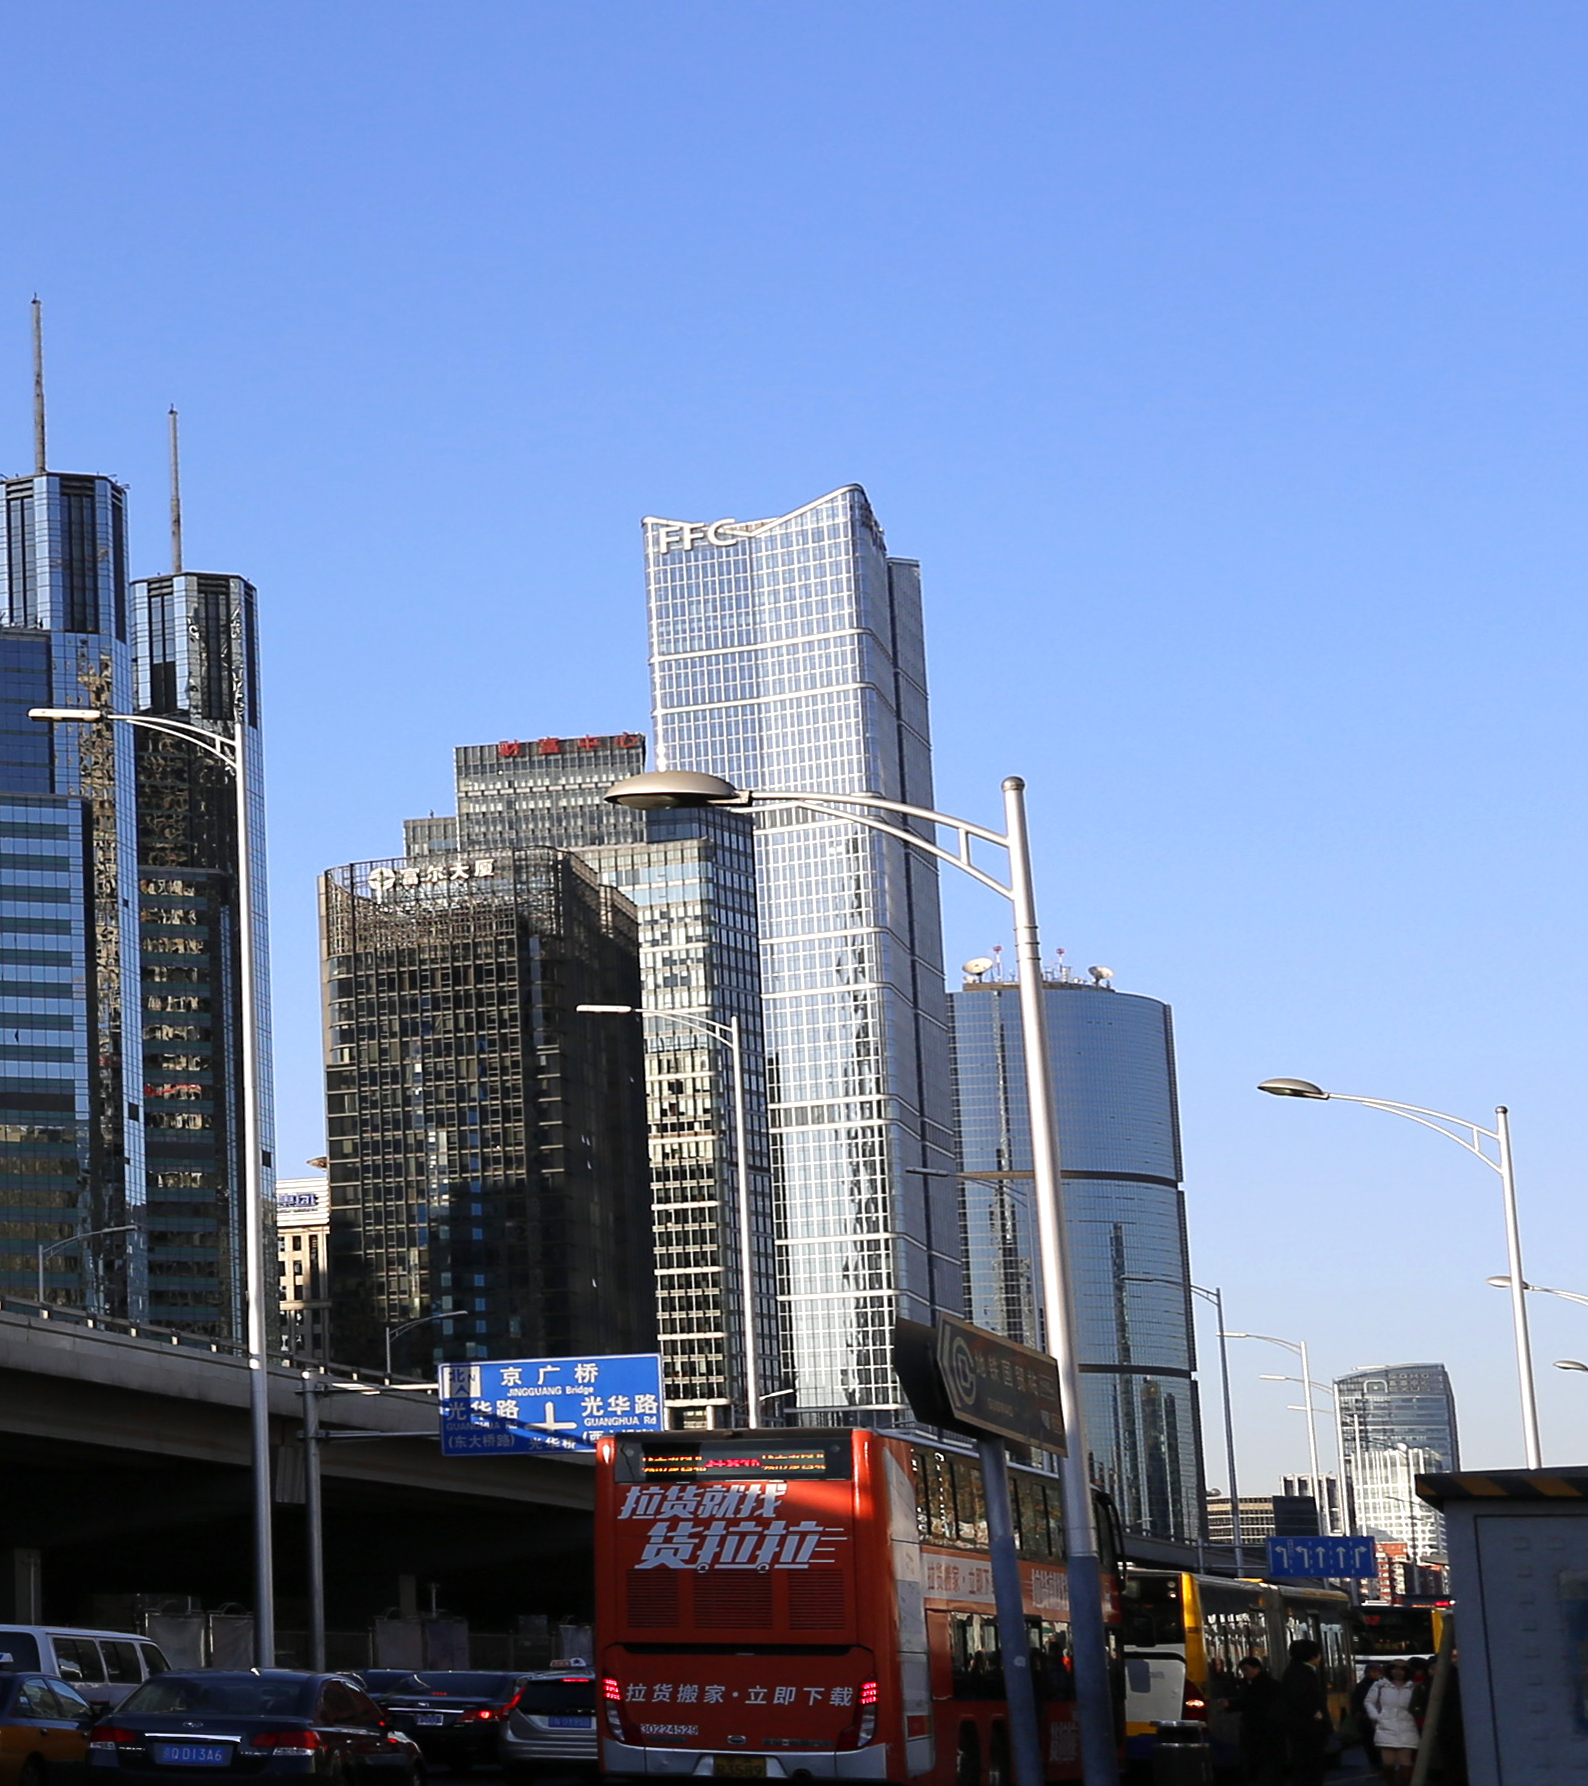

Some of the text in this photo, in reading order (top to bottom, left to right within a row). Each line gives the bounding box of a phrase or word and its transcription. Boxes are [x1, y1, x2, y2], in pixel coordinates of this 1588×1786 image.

[659, 517, 737, 555] FFC
[498, 731, 641, 757] 财富中心
[399, 858, 496, 886] 富尔大厦
[449, 1368, 465, 1383] 北
[468, 1373, 476, 1382] N
[499, 1363, 600, 1387] 京广桥
[507, 1385, 594, 1398] JINGGUANG Bridge
[446, 1399, 520, 1421] 光华路
[581, 1393, 659, 1417] 光华路
[446, 1421, 501, 1431] GUANGHUA
[584, 1416, 657, 1427] GUANGHUA Rd
[447, 1434, 516, 1449] (东大桥路)
[528, 1436, 577, 1450] 光华桥
[617, 1484, 788, 1520] 拉货就找
[634, 1520, 825, 1573] 货拉拉
[624, 1682, 855, 1708] 拉货搬家·立即下载
[641, 1723, 700, 1736] 30224529
